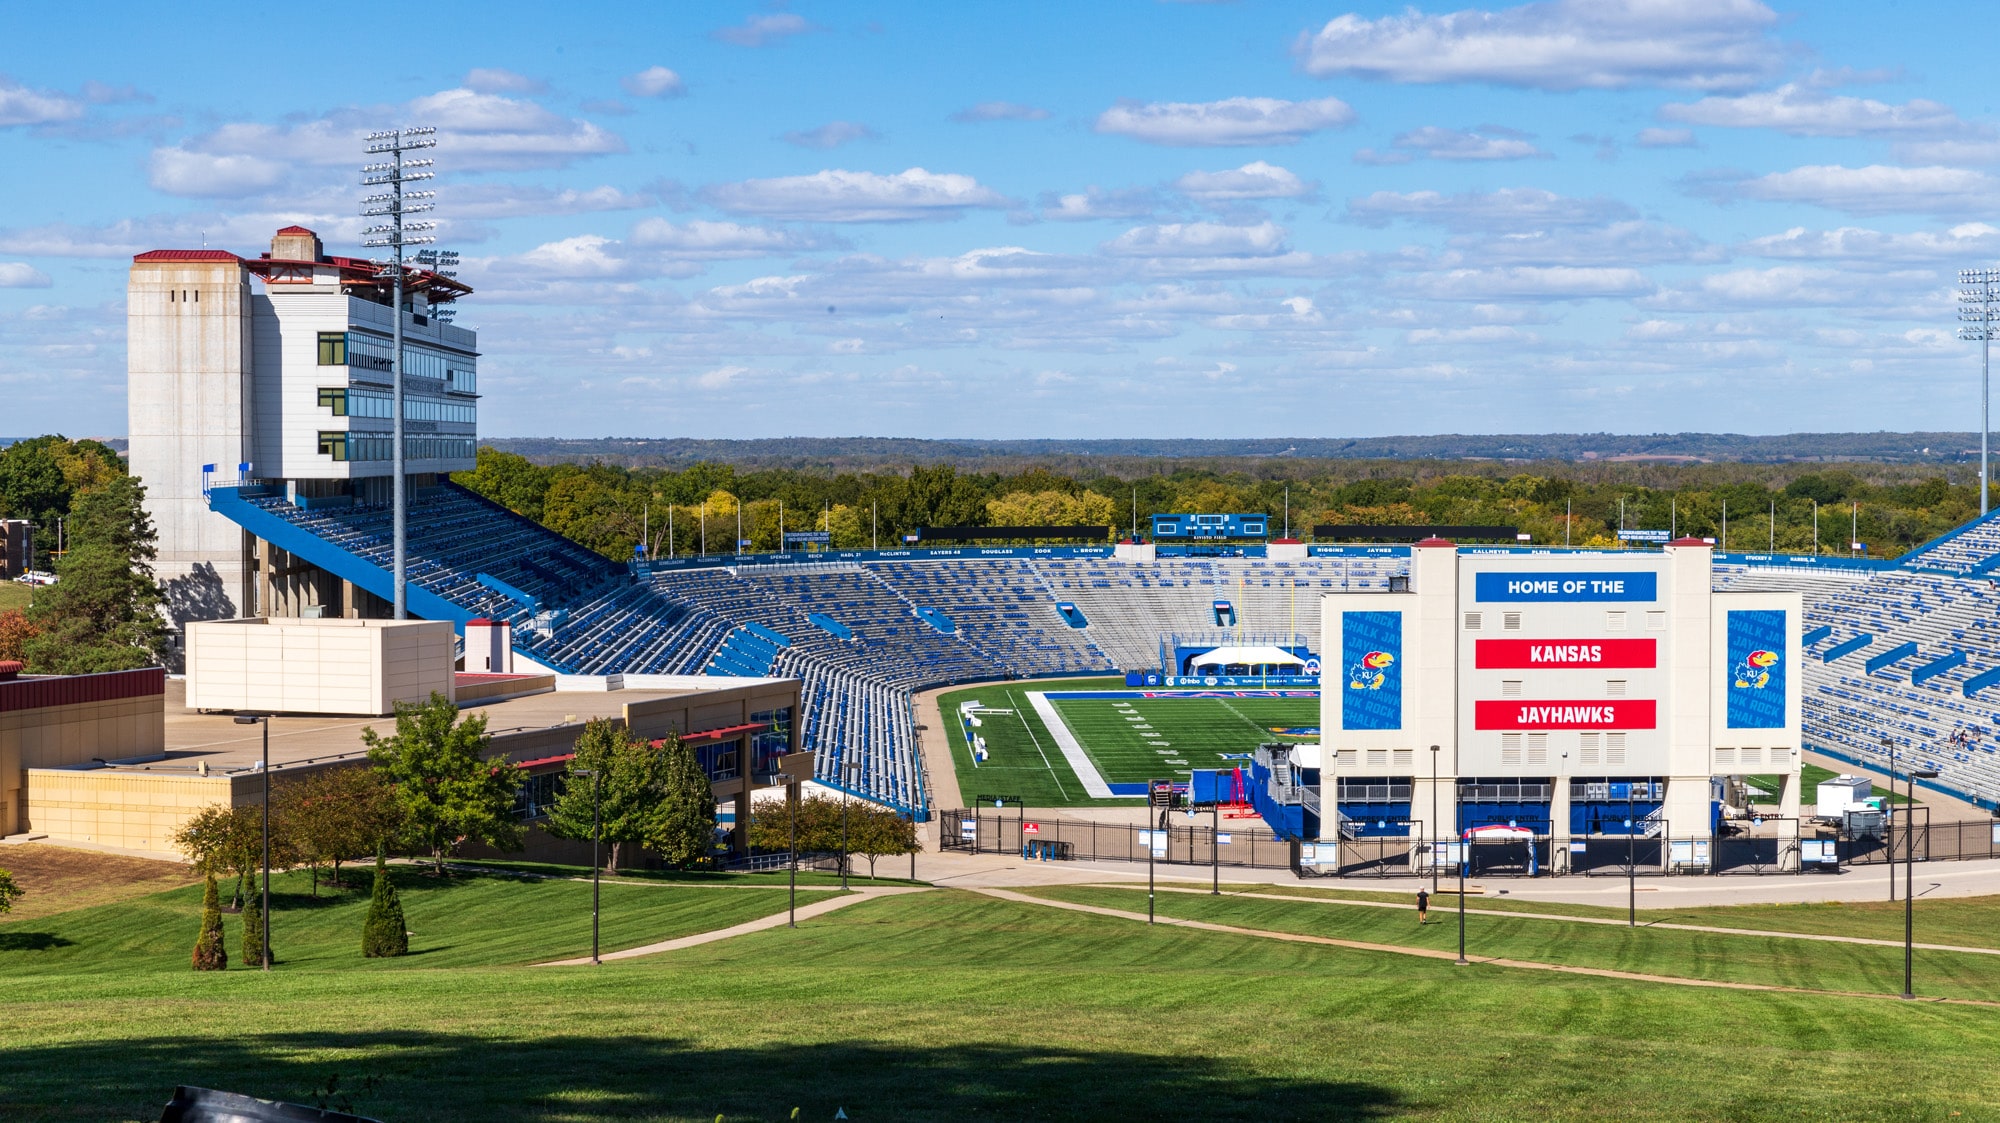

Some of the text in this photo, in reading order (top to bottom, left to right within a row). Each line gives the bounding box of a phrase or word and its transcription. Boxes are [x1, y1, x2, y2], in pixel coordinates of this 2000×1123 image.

[1508, 580, 1624, 593] HOME OF THE
[1344, 618, 1378, 639] CHALK
[1728, 618, 1763, 638] CHALK
[1530, 645, 1601, 662] KANSAS
[1365, 701, 1396, 719] ROCK
[1517, 706, 1614, 724] JAYHAWKS
[1728, 707, 1764, 728] CHALK
[1750, 699, 1780, 718] ROCK
[1344, 709, 1378, 729] CHALK
